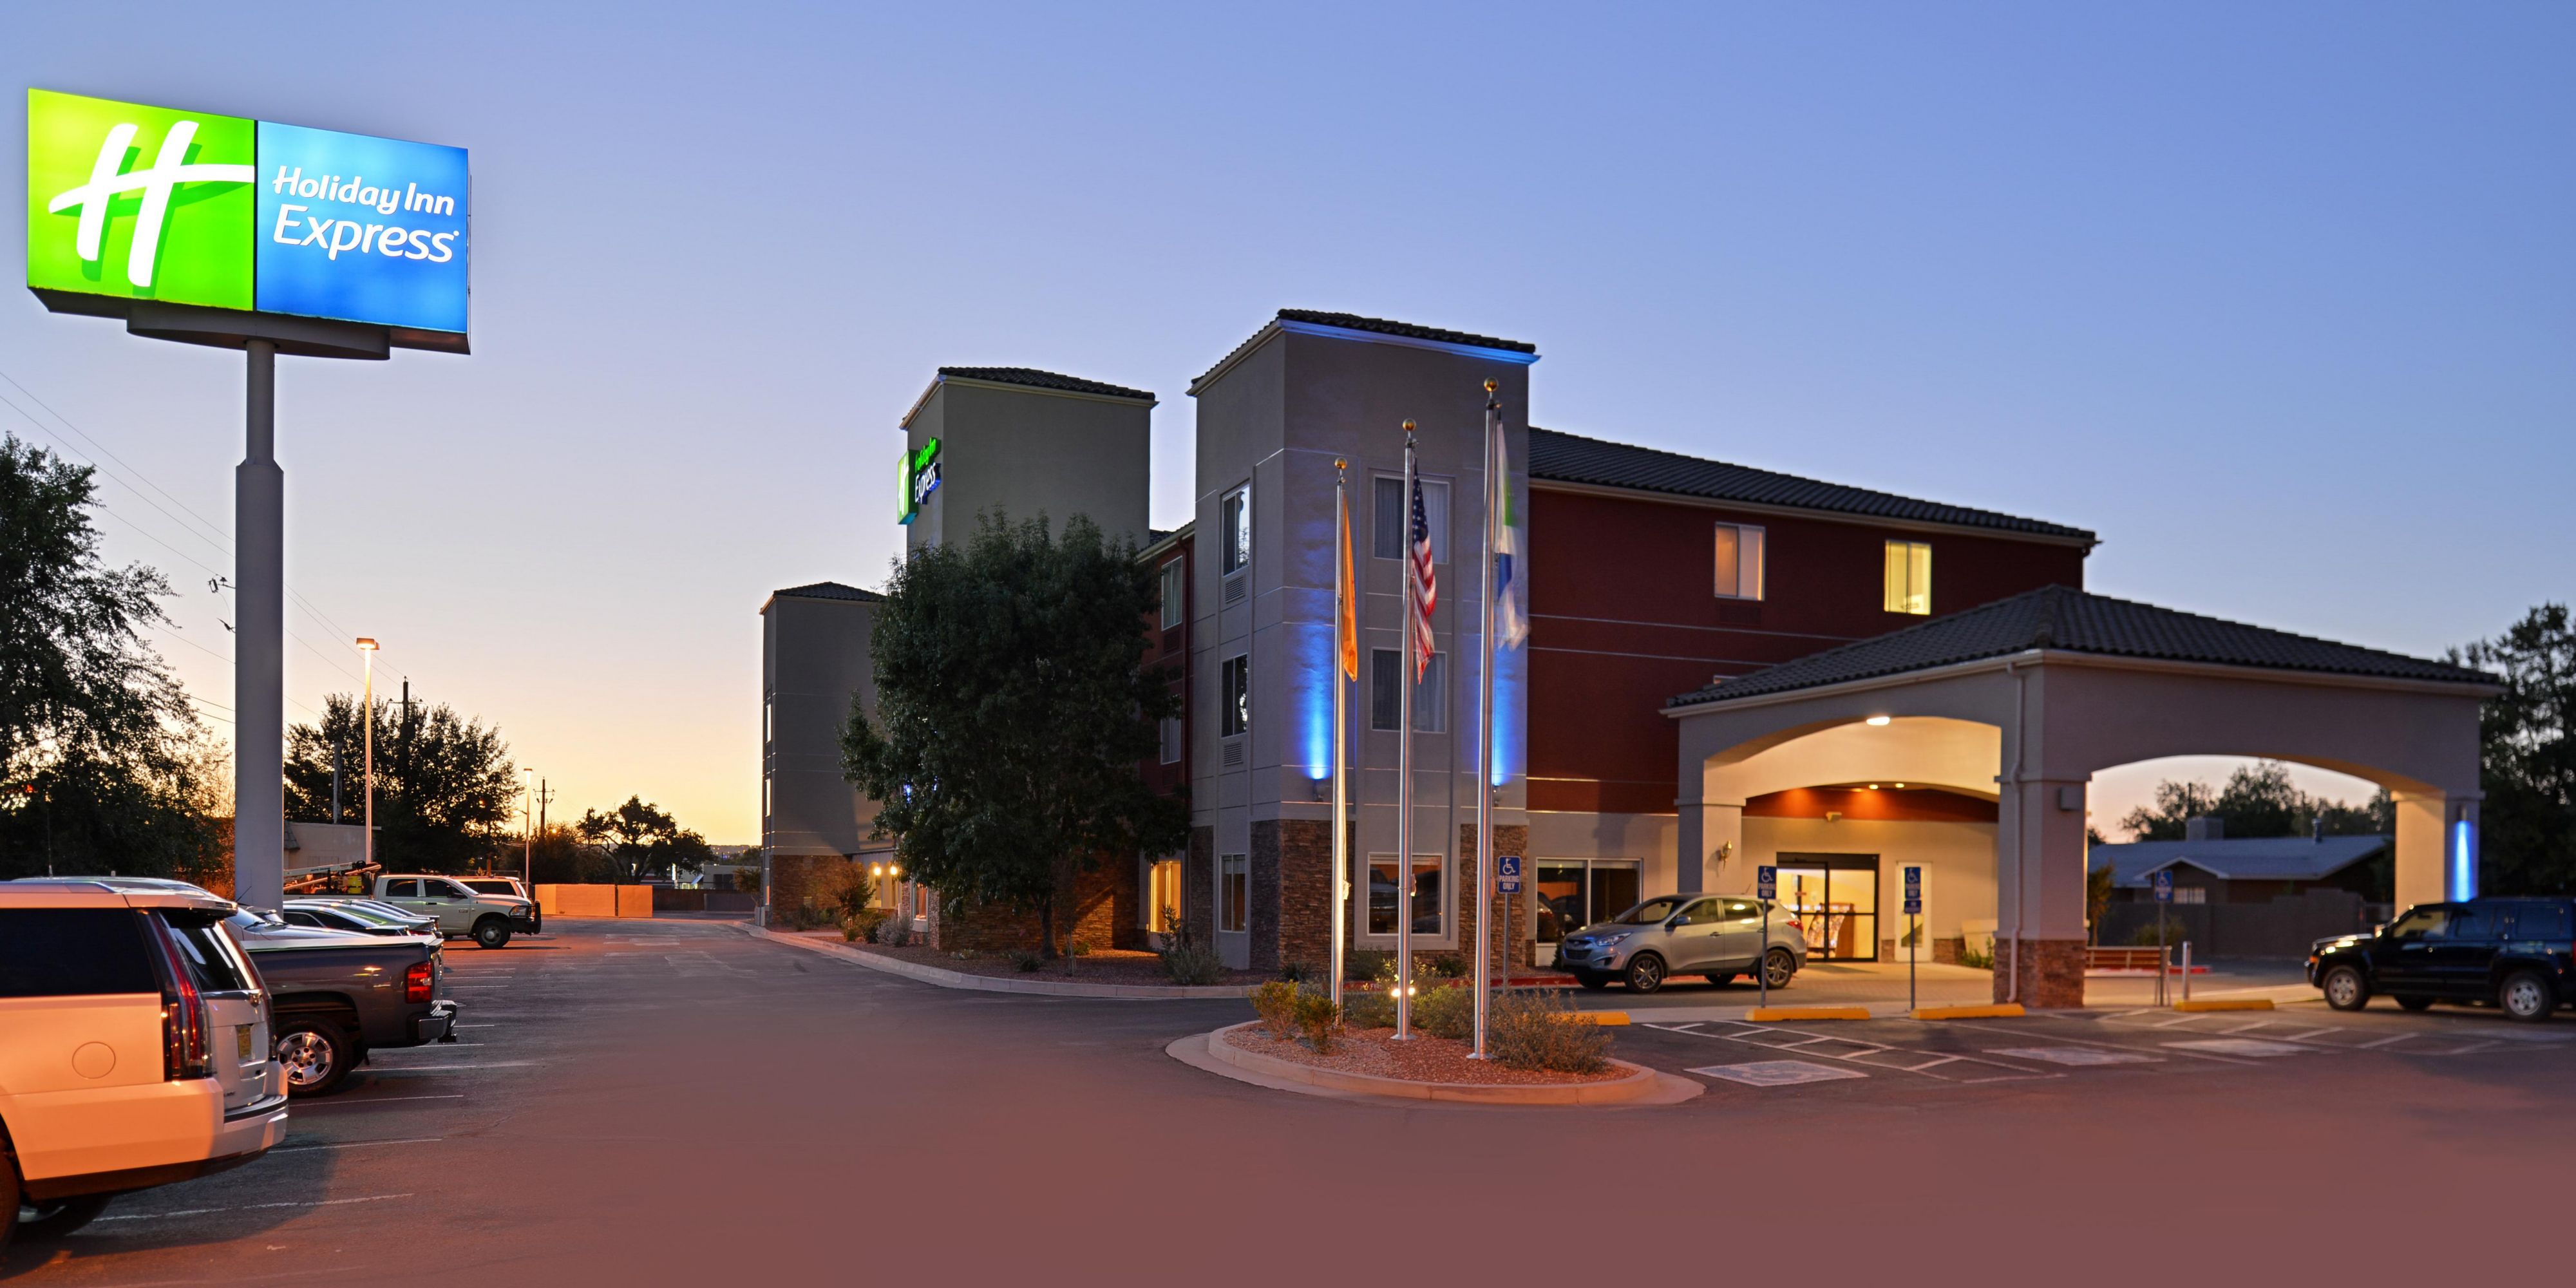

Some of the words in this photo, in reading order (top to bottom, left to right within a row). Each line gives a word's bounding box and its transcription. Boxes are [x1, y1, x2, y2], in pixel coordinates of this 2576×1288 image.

[272, 165, 401, 214] Holiday
[404, 182, 455, 216] Inn
[273, 203, 459, 263] Express
[915, 462, 935, 504] Express
